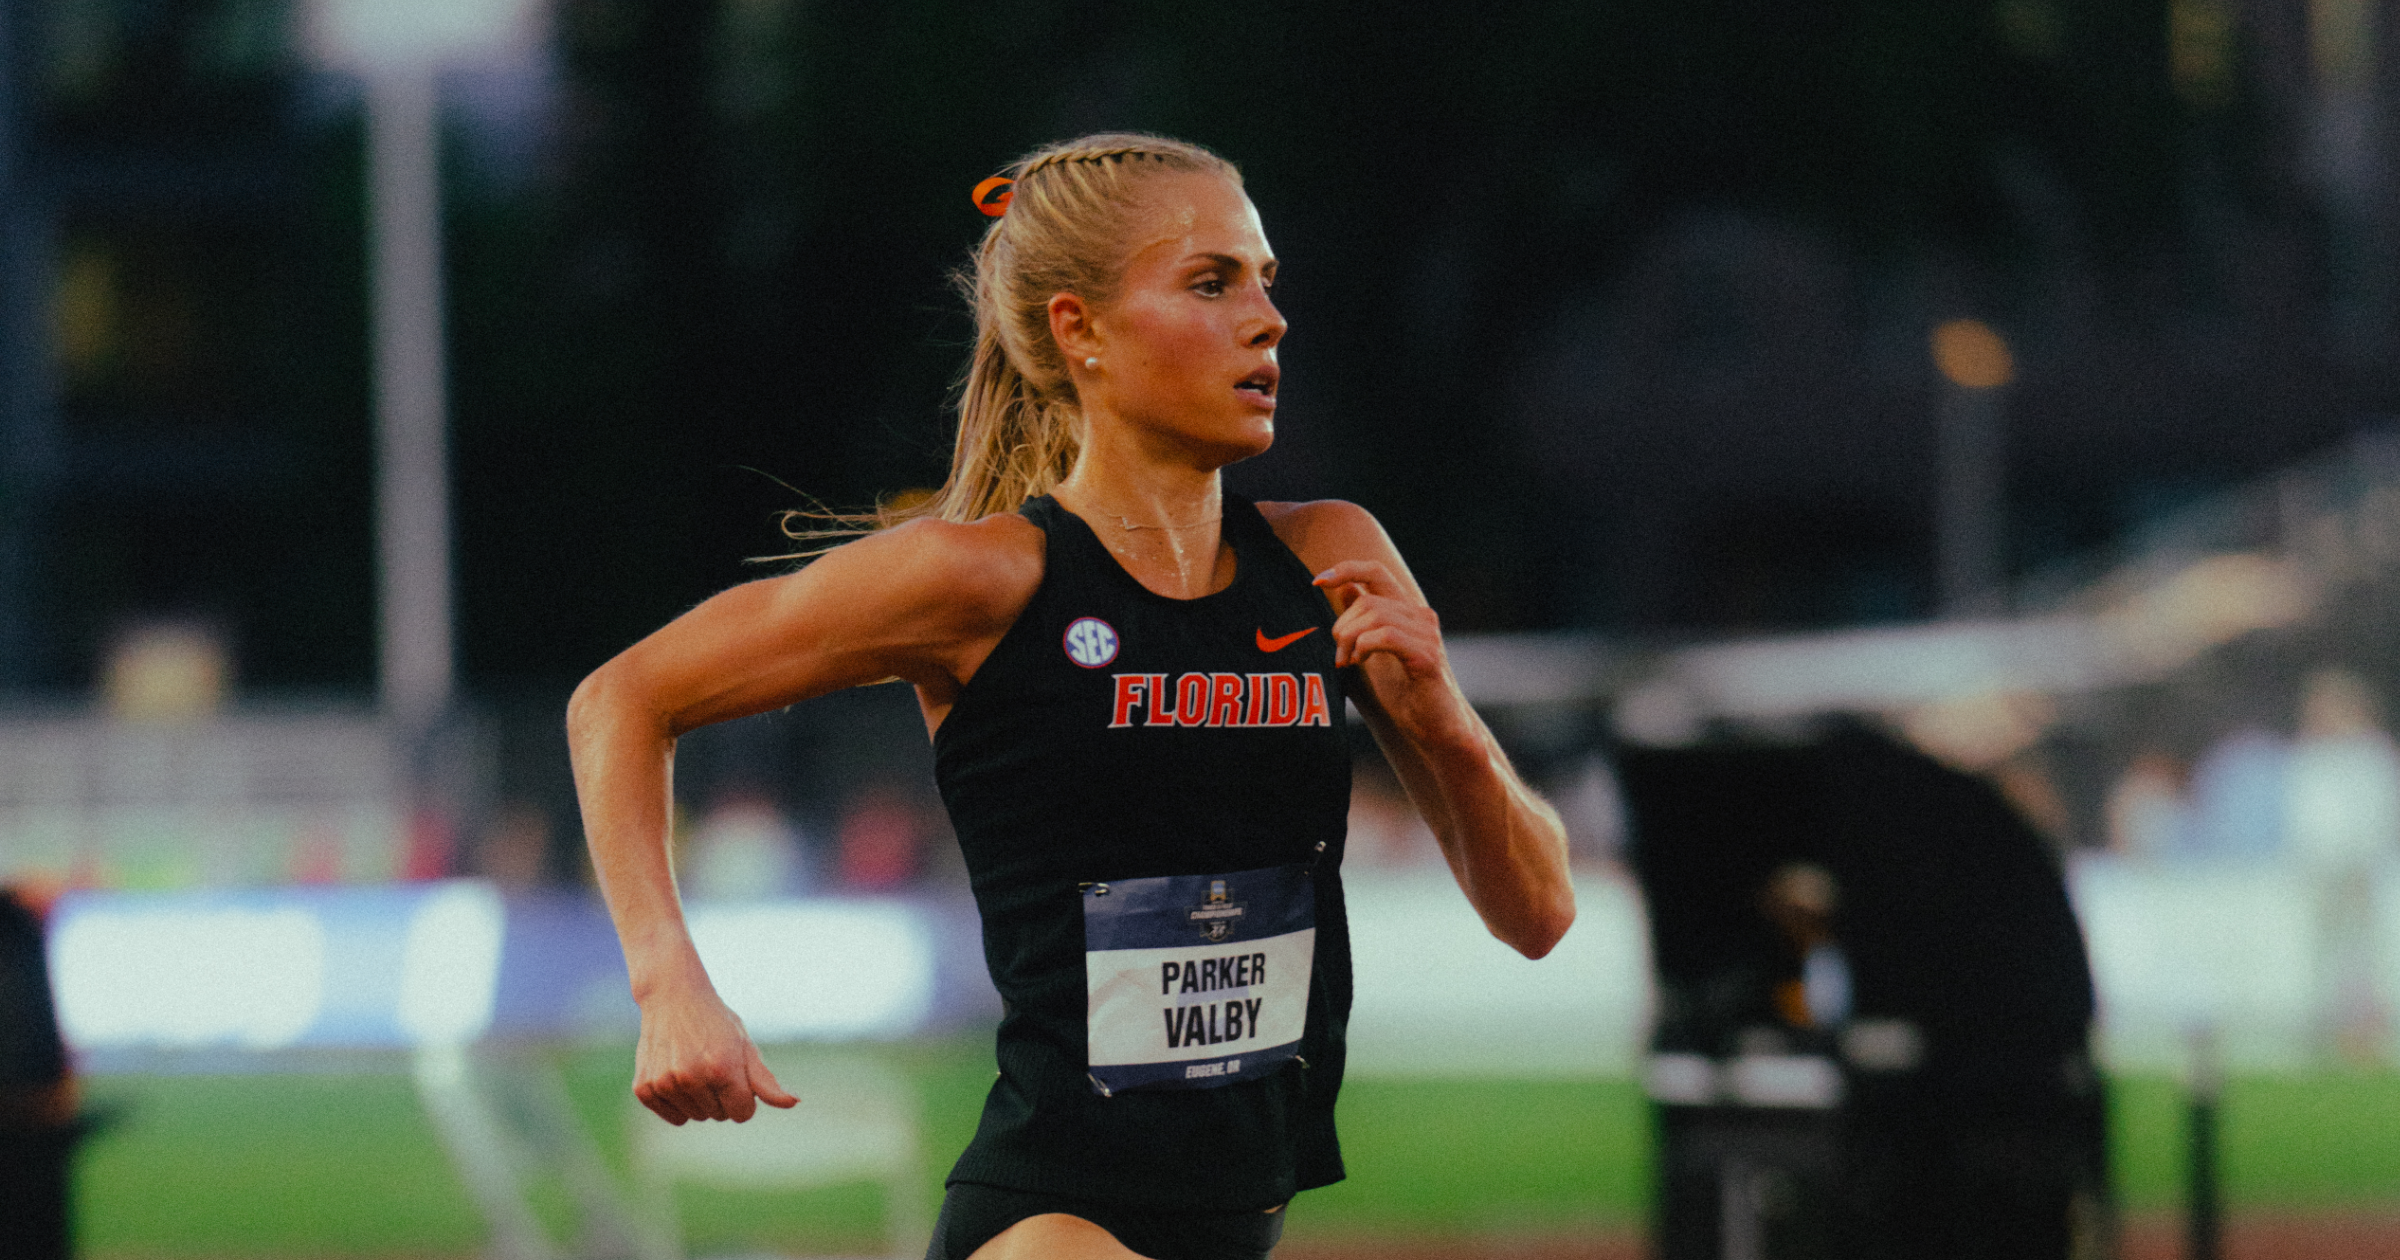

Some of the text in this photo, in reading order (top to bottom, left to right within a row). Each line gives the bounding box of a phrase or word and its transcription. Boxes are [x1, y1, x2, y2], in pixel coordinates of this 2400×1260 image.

[1066, 620, 1116, 666] SEC
[1107, 672, 1331, 728] FLORIDA
[1162, 953, 1266, 995] PARKER
[1164, 997, 1262, 1049] VALBY
